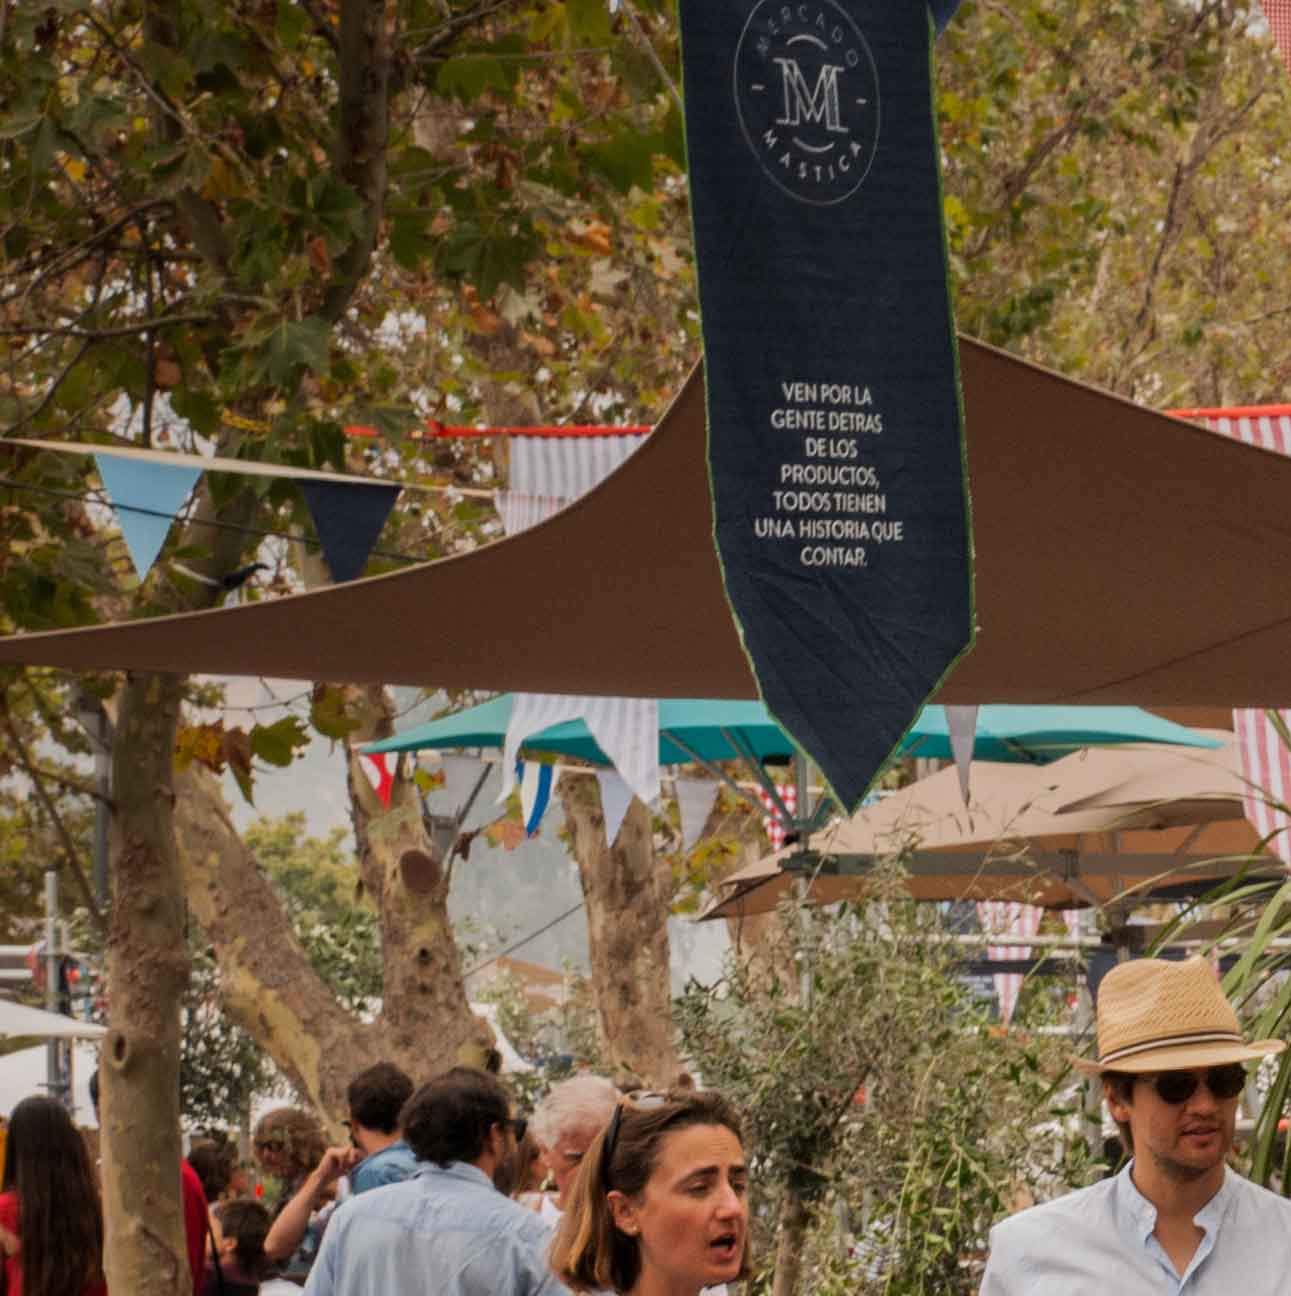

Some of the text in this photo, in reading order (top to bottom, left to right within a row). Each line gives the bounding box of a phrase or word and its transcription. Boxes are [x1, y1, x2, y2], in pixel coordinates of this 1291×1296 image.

[757, 5, 858, 67] MERCADO
[763, 128, 862, 182] MASTICA
[782, 382, 872, 405] VEN POR LA
[771, 409, 883, 434] GENTE DETRAS
[806, 437, 858, 458] DE LOS
[781, 464, 880, 489] PRODUCTOS,
[772, 491, 885, 513] TODOS TIENEN
[754, 517, 904, 544] UNA HISTORIA QUE
[801, 547, 868, 567] CONTAR.
